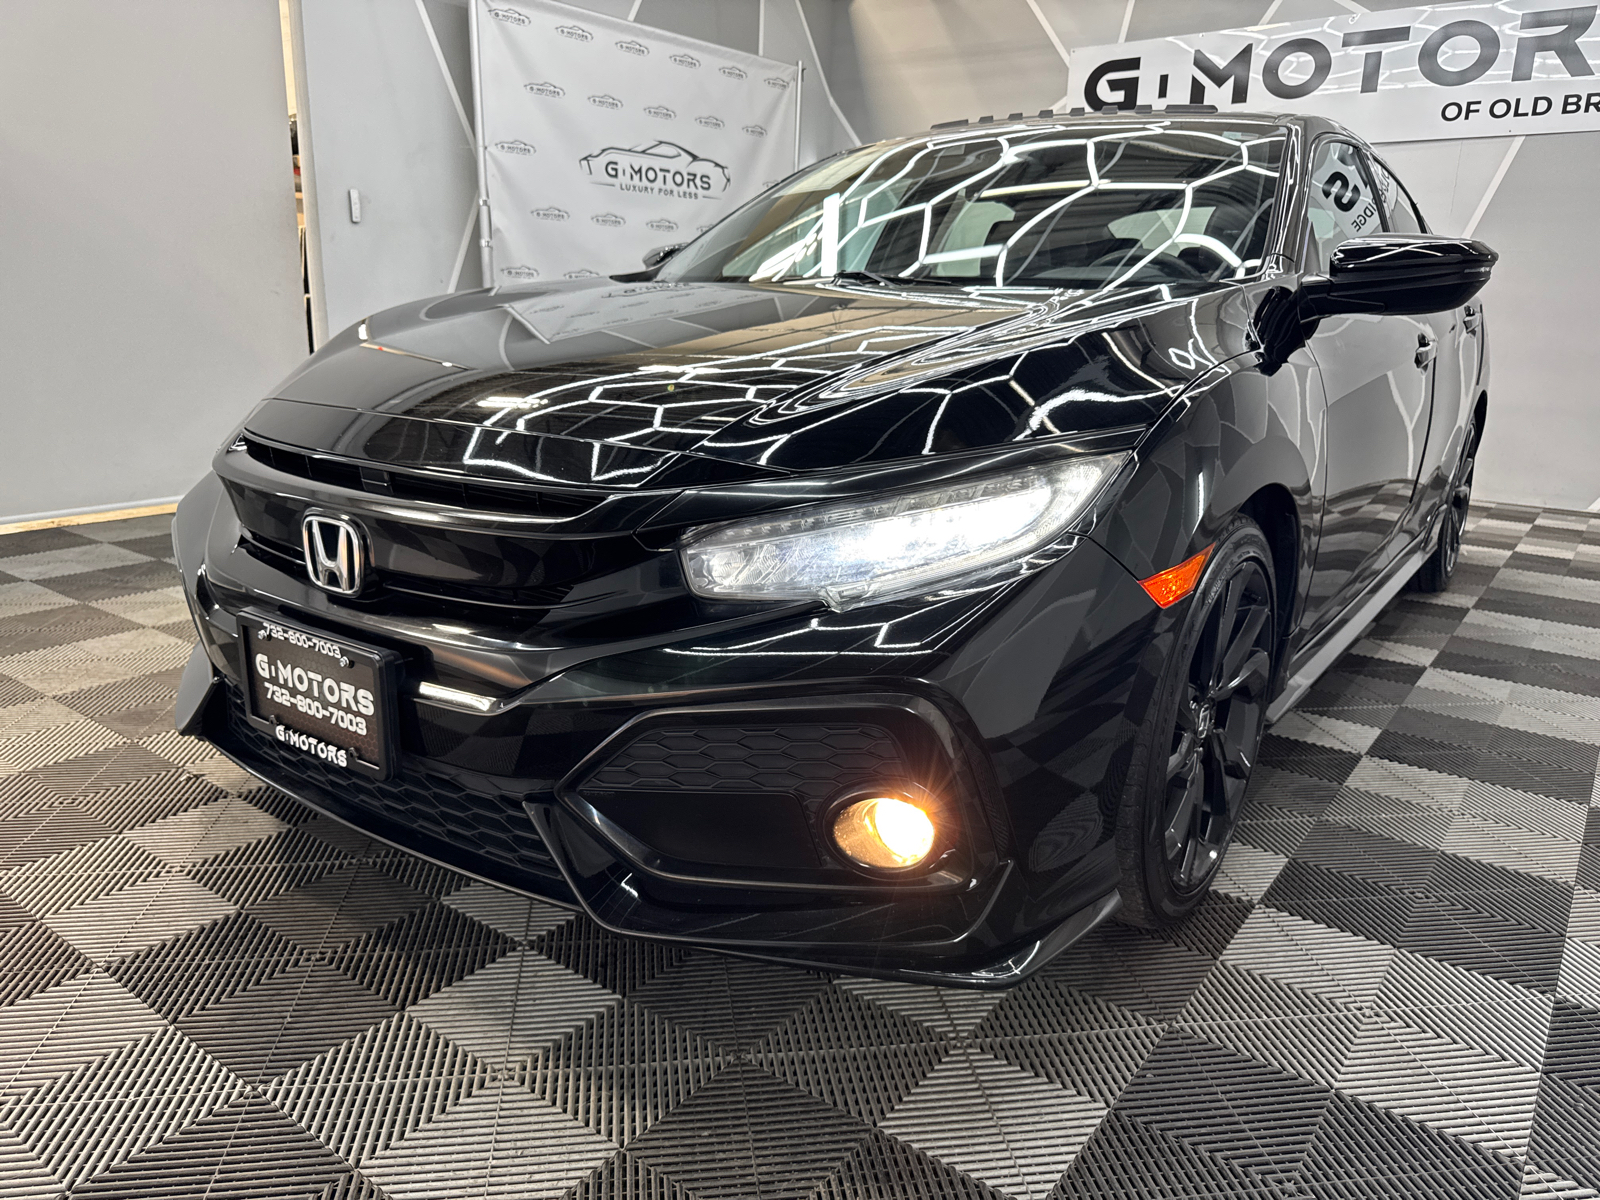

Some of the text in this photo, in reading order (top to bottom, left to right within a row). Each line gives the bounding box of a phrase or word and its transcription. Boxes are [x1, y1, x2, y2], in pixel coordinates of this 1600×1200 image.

[1440, 100, 1482, 122] OF
[1488, 96, 1552, 119] OLD
[620, 183, 699, 200] LUXURY FOR LESS
[262, 622, 342, 659] 732-800-7003
[264, 682, 368, 736] 732-800-7003
